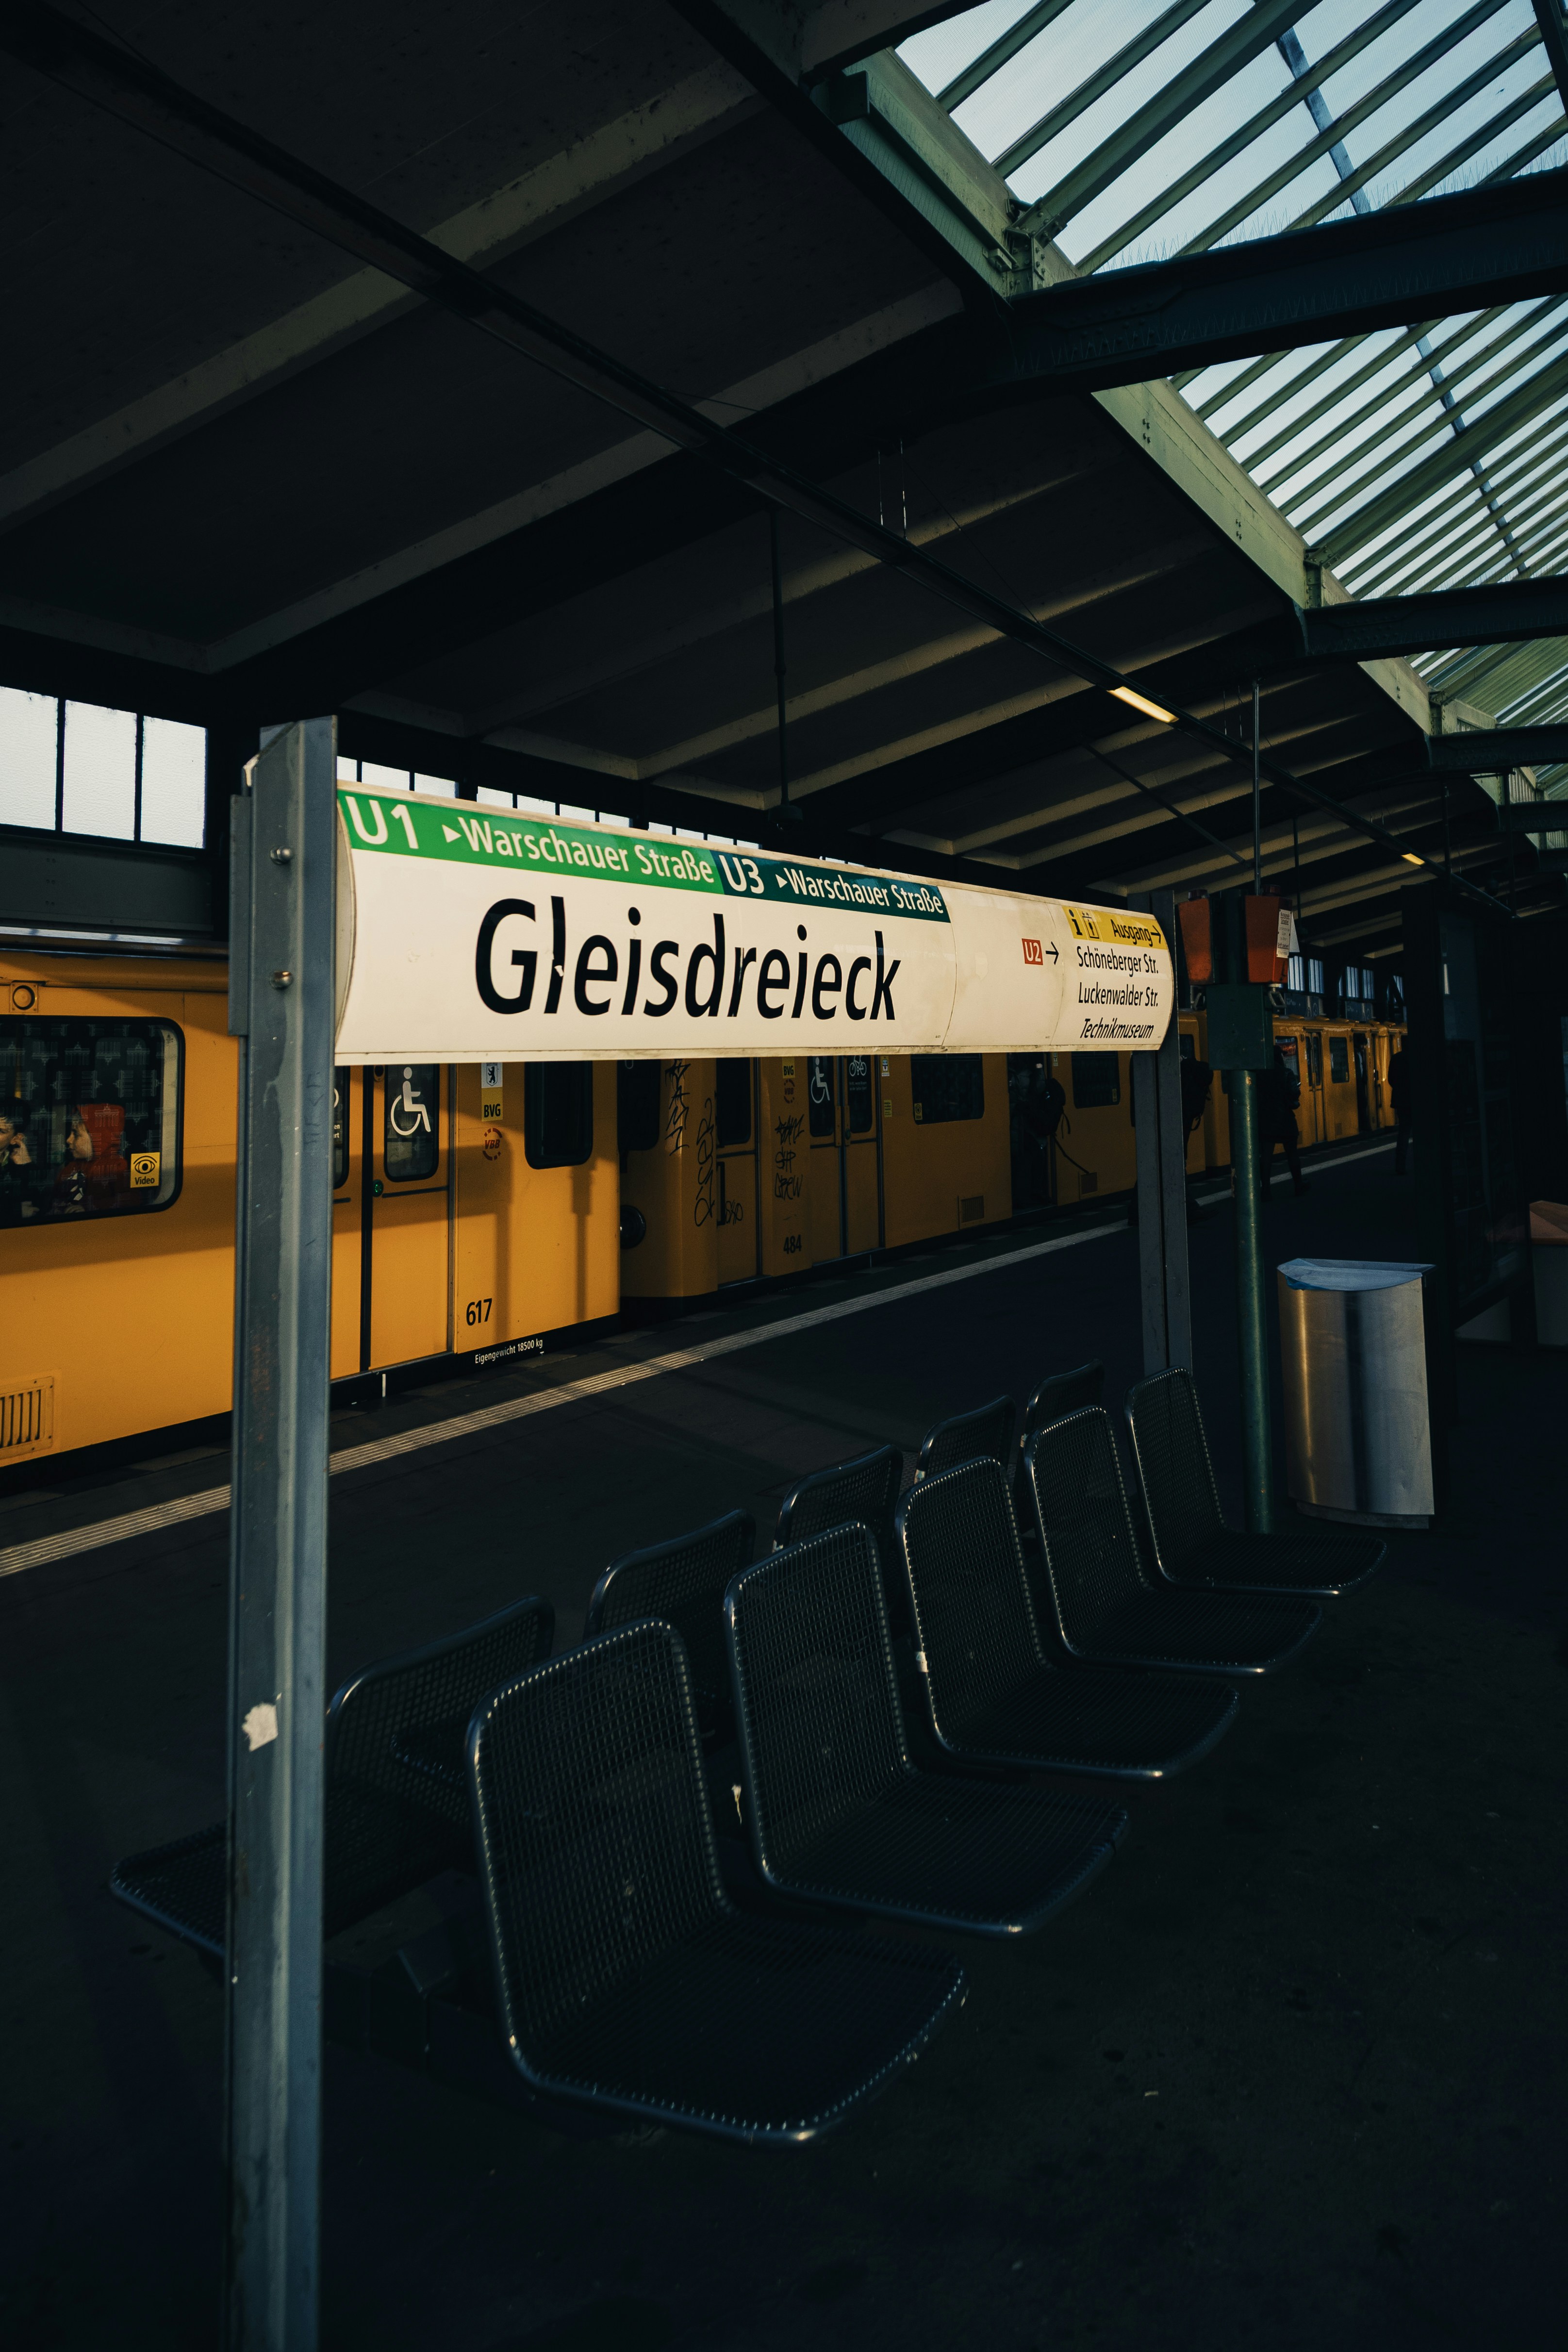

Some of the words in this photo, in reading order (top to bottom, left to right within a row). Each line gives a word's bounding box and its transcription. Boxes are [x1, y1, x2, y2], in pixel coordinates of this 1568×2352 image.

[344, 795, 419, 850] U1
[457, 816, 629, 873] Warschauer
[635, 845, 715, 884] Straße
[719, 855, 765, 894] U3
[783, 867, 891, 908] Warschauer
[891, 885, 944, 914] Straße
[1110, 919, 1153, 947] Ausgang
[475, 895, 901, 1021] Gleisdreieck
[1024, 942, 1041, 962] U2
[1077, 946, 1141, 977] Schöneberger
[1143, 954, 1158, 974] Str.
[1078, 982, 1143, 1006] Luckenwalder
[1145, 987, 1158, 1007] Str.
[1080, 1017, 1154, 1038] Technikmuseum
[784, 1065, 794, 1076] BVG
[484, 1103, 501, 1118] BVG
[485, 1139, 500, 1150] VBB
[135, 1176, 155, 1185] Video
[784, 1235, 802, 1254] 484
[466, 1298, 492, 1326] 617
[475, 1345, 515, 1364] Eigengewicht
[517, 1340, 534, 1352] 18500
[536, 1338, 543, 1348] kg
